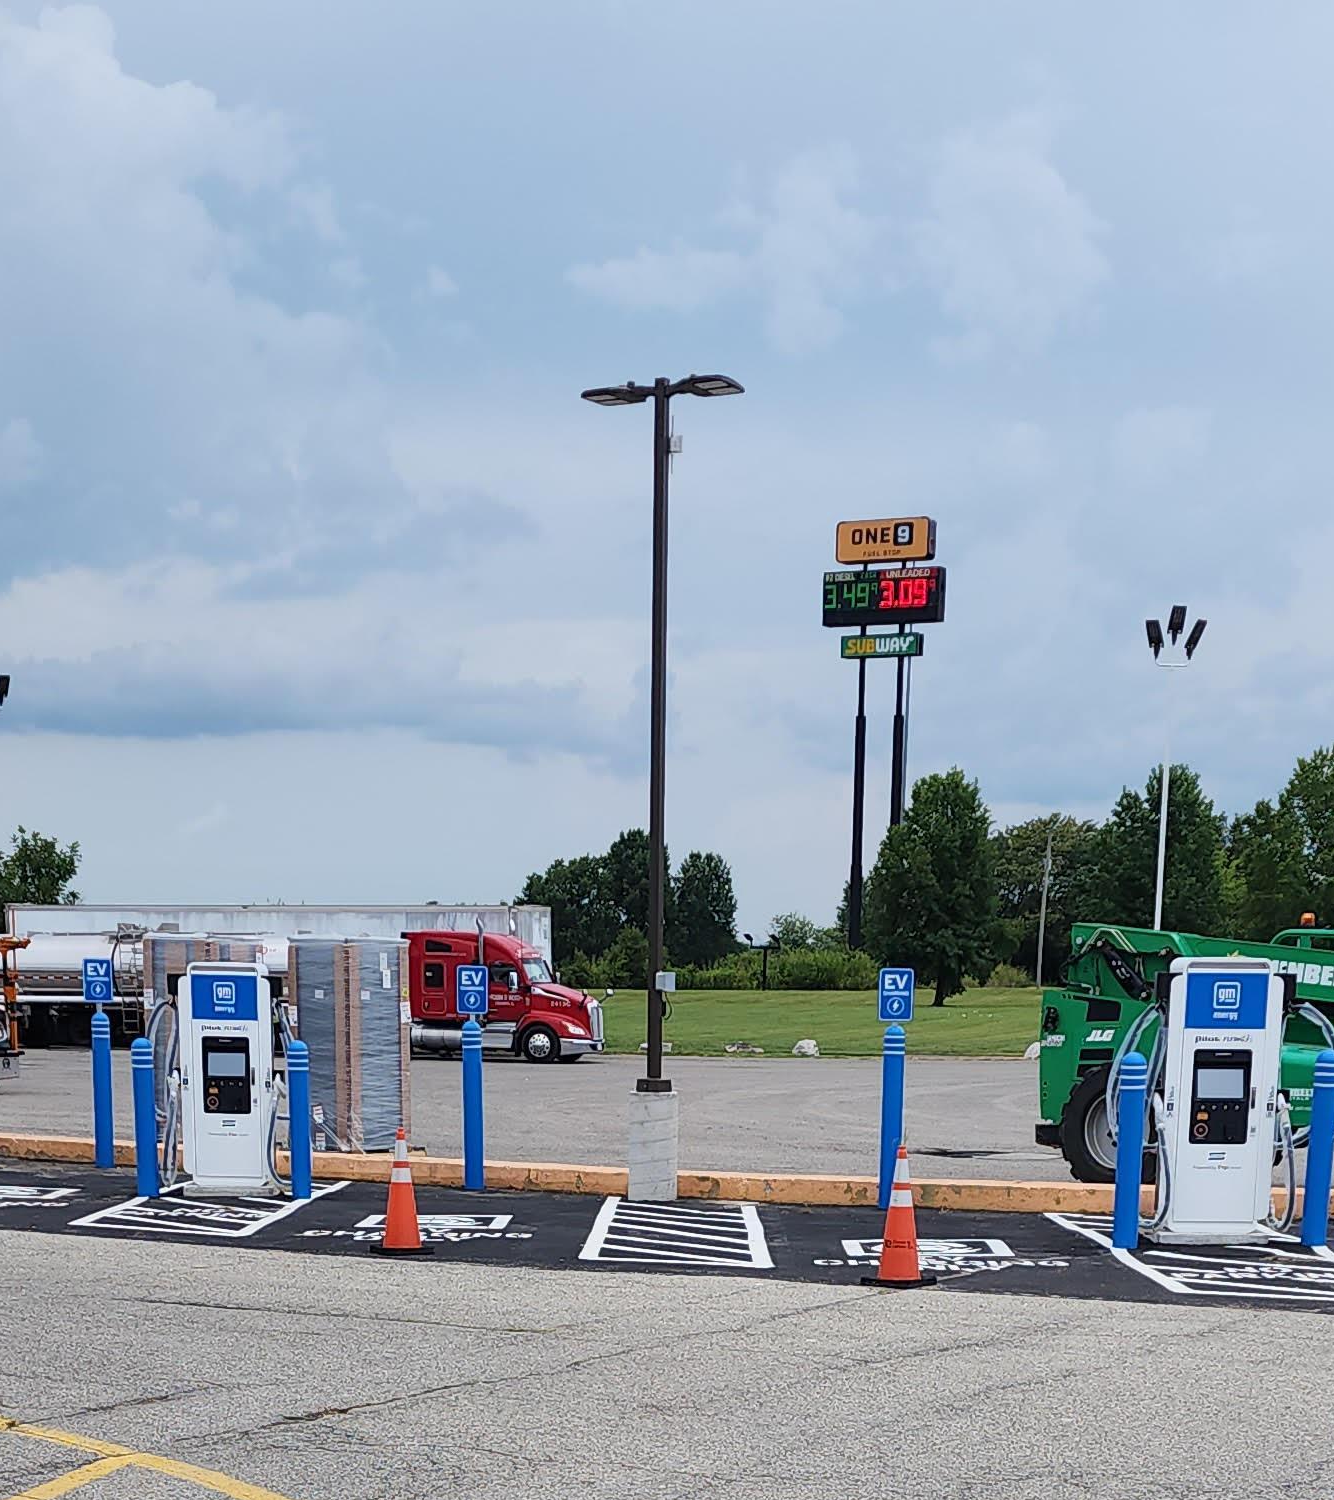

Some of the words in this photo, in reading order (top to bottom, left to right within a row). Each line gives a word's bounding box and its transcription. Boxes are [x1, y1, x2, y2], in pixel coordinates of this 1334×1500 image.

[886, 568, 931, 578] UNLEADED
[845, 636, 914, 654] SUBWAY
[87, 963, 107, 976] EV
[462, 971, 482, 985] EV
[885, 974, 908, 989] EV
[1086, 1030, 1115, 1041] JLG
